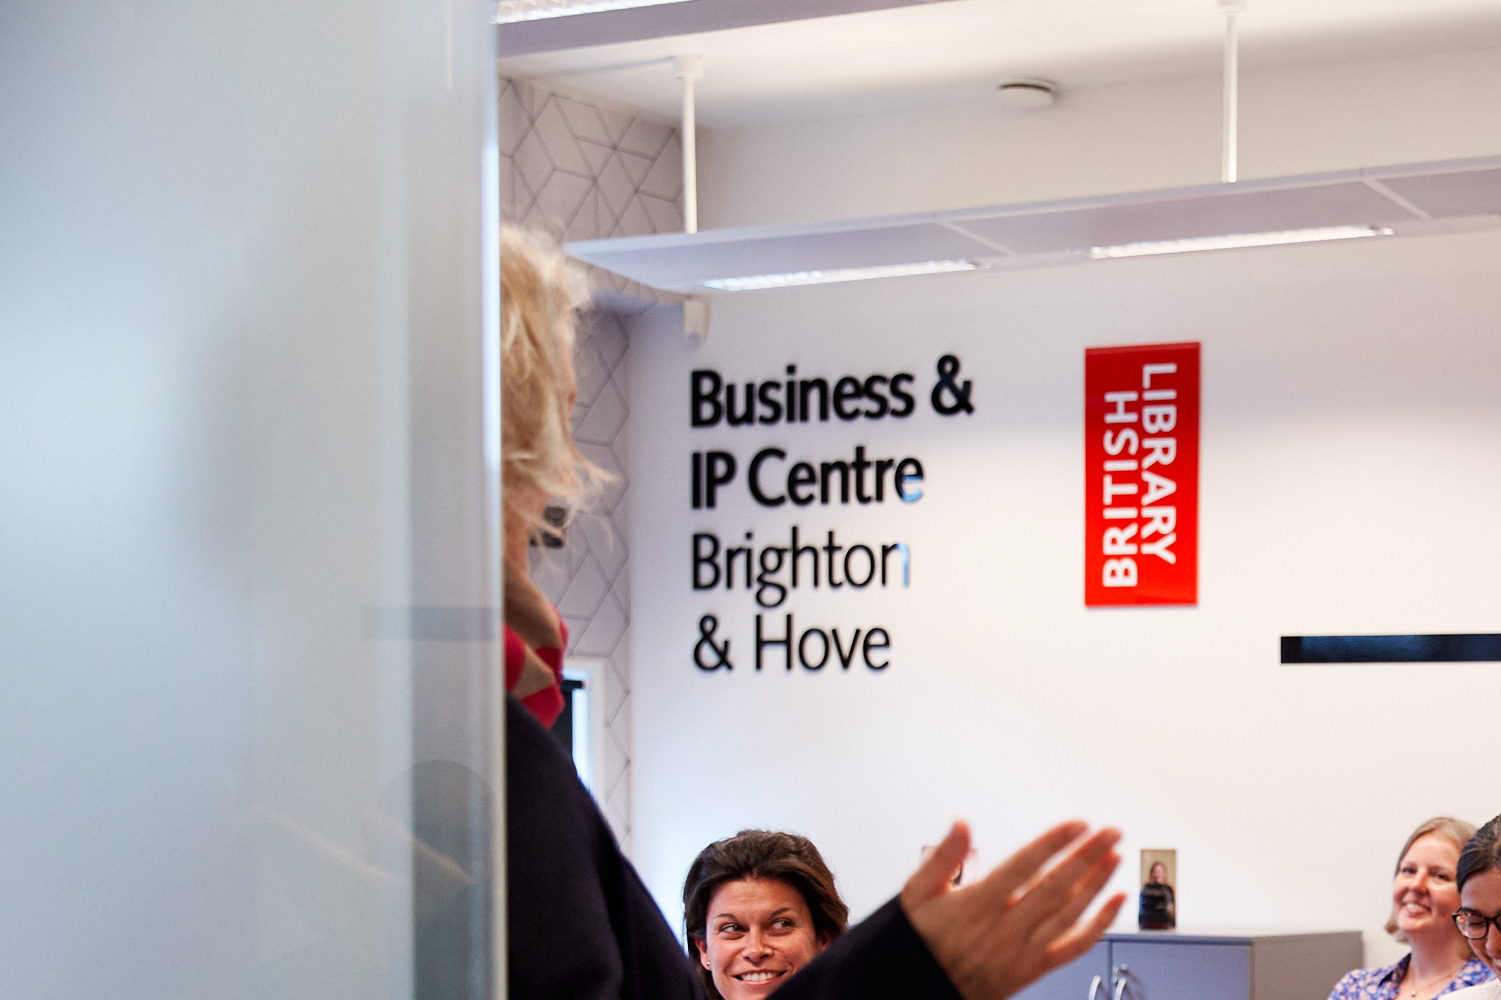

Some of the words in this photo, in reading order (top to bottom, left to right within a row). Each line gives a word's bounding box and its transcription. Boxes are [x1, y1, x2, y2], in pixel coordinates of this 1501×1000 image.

[690, 365, 916, 429] Business
[930, 354, 976, 417] &
[690, 451, 738, 509] IP
[747, 445, 925, 508] Centre
[1102, 390, 1139, 588] BRITISH
[1142, 363, 1177, 565] LIBRARY
[691, 525, 911, 609] Brighton
[693, 613, 734, 672] &
[755, 613, 892, 672] Hove
